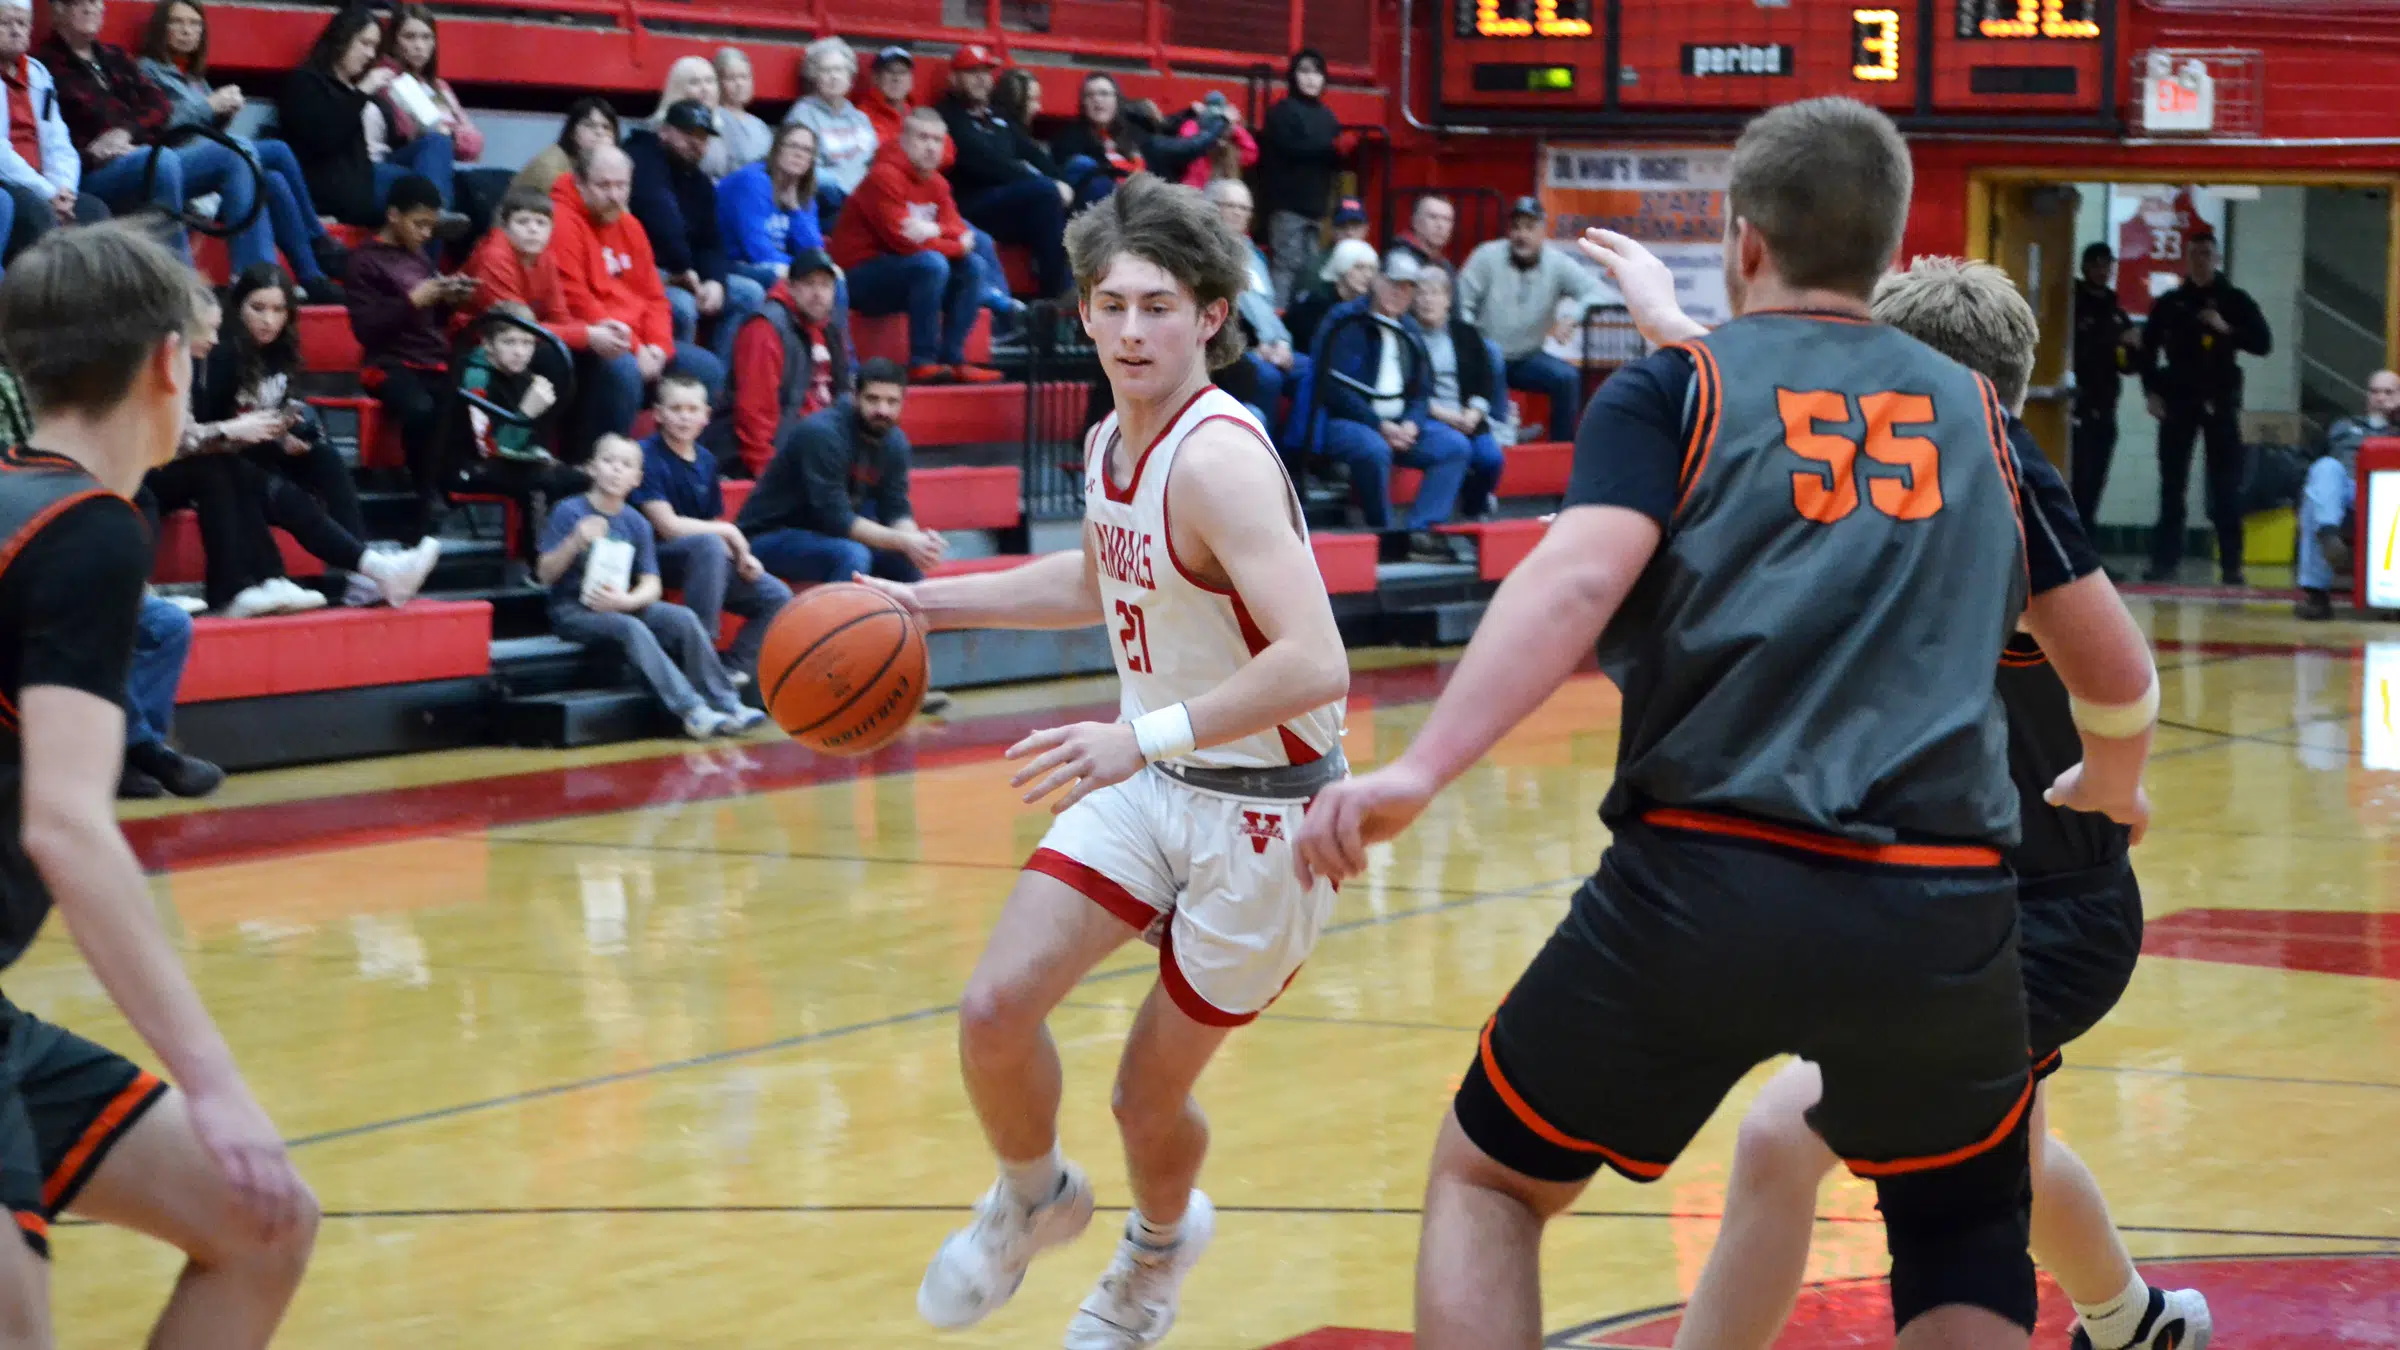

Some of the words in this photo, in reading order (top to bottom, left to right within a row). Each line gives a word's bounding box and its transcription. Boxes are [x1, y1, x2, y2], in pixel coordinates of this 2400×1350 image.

[1693, 43, 1782, 78] period
[1853, 9, 1899, 81] 3
[1556, 215, 1724, 242] SPORTSMAN
[2150, 229, 2182, 260] 33
[1775, 385, 1944, 525] 55
[1093, 521, 1156, 591] ANDALS
[1115, 598, 1153, 674] 21
